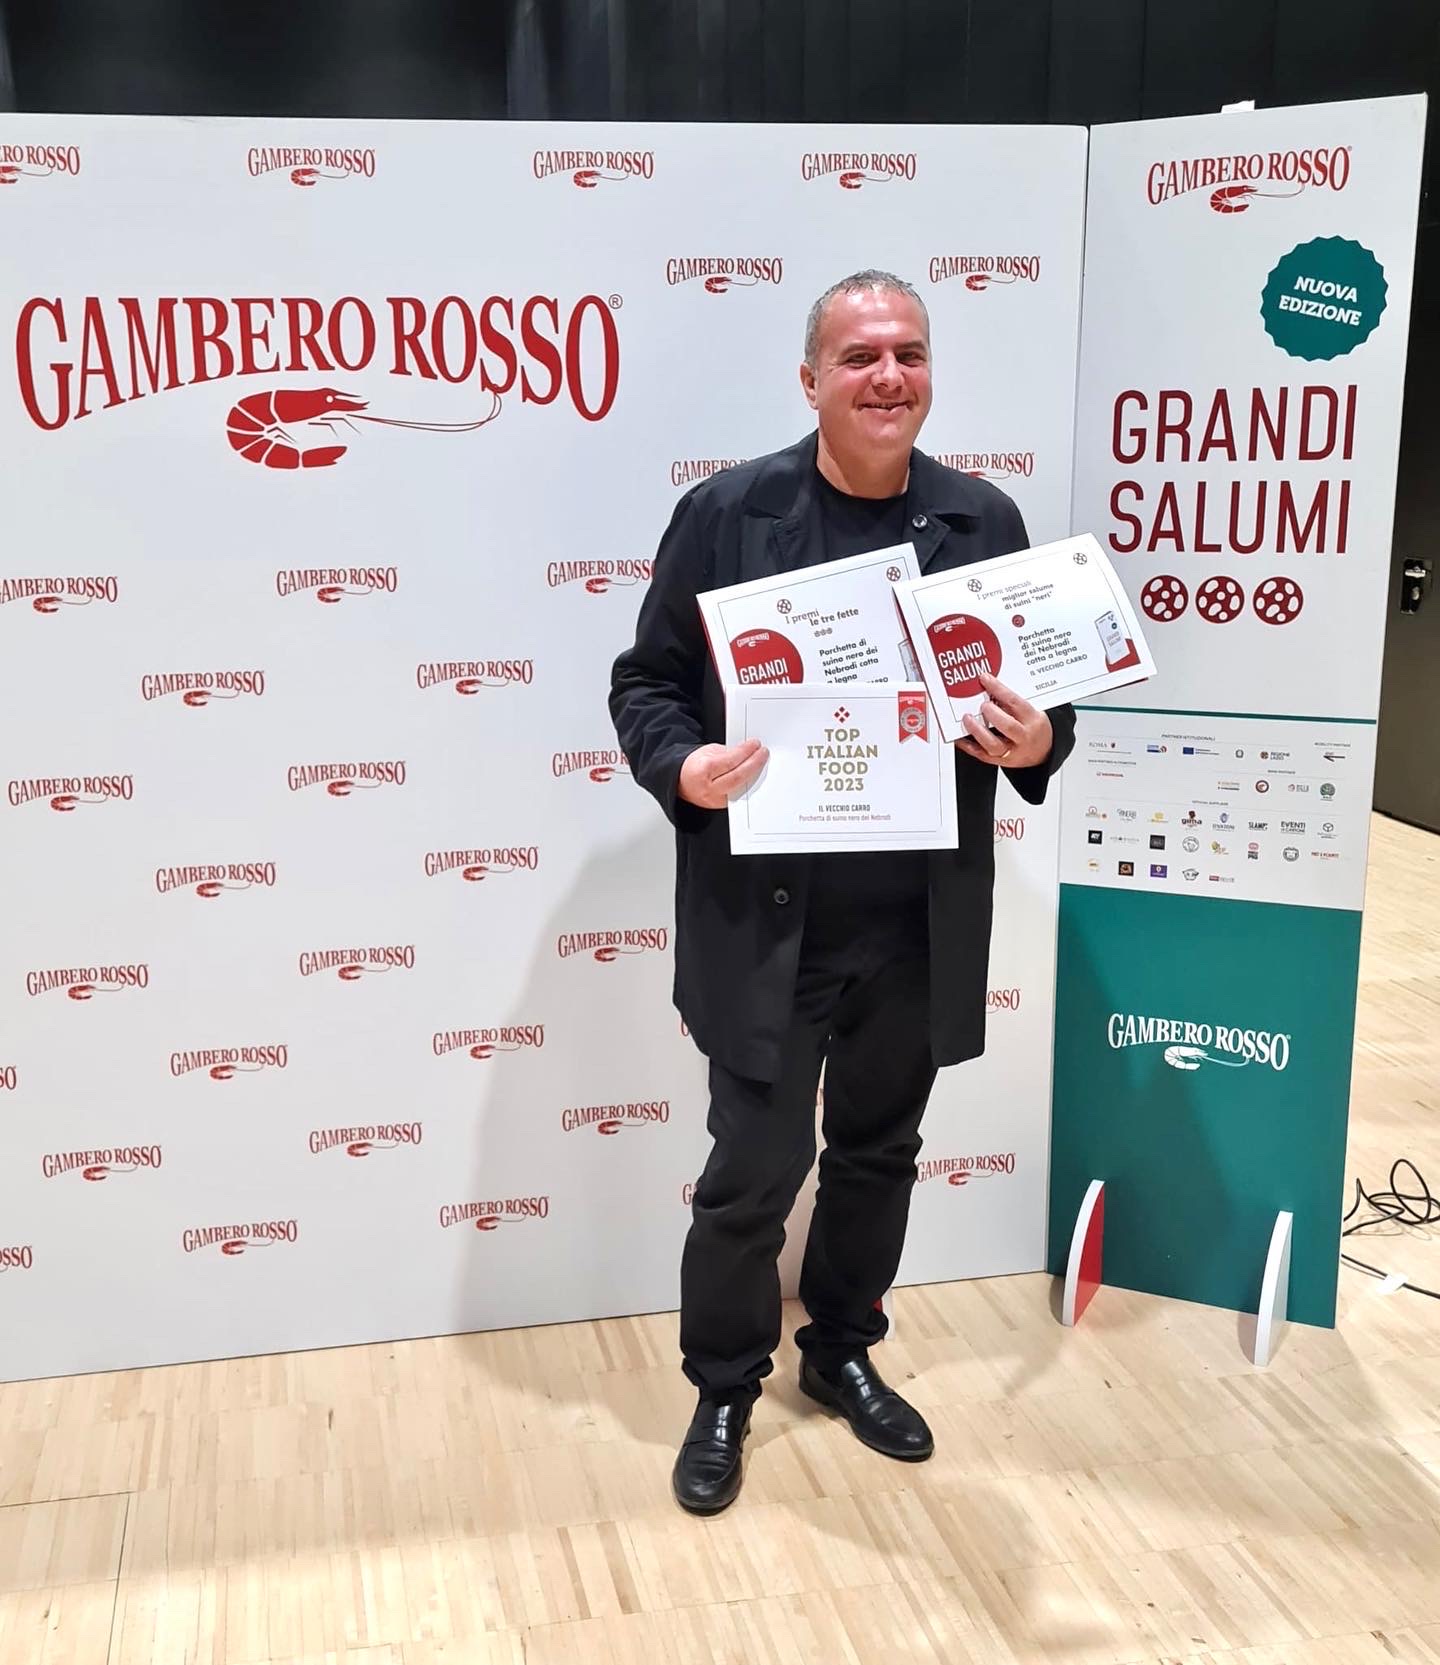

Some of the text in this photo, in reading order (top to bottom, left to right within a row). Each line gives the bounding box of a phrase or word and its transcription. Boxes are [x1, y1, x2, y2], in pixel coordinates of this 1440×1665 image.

[26, 144, 80, 176] ROSSO
[248, 148, 376, 178] GAMBERO ROSSO
[533, 151, 654, 180] GAMBERO ROSSO
[802, 153, 916, 181] GAMBERO ROSSO
[1148, 146, 1352, 205] GAMBERO ROSSO
[667, 257, 783, 285] GAMBERO ROSSO
[929, 255, 1040, 283] GAMBERO ROSSO
[1293, 276, 1358, 304] NUOVA
[1278, 294, 1363, 326] EDIZIONE
[15, 296, 376, 431] GAMBERO
[1111, 384, 1358, 464] GRANDI
[991, 452, 1034, 478] ROSSO
[1108, 479, 1352, 555] SALUMI
[277, 567, 398, 597] GAMBERO ROSSO
[547, 560, 615, 588] GAMBERO
[0, 576, 118, 602] AMBERO ROSSO
[1002, 583, 1054, 602] miglior salume
[1013, 598, 1031, 608] suini
[791, 608, 820, 624] premi
[820, 614, 835, 624] tre
[837, 608, 859, 620] fette
[819, 638, 867, 656] Porchetta di
[1018, 628, 1055, 643] Porchetta
[1021, 631, 1072, 650] di suino nero
[1024, 637, 1070, 658] dei Nebrodi
[822, 646, 878, 667] suino nero dei
[824, 657, 879, 677] Nebrodi cotta
[938, 640, 986, 669] GRANDI
[1027, 655, 1046, 665] cotta
[1055, 646, 1078, 656] legna
[1036, 661, 1065, 674] VECCHIO
[1065, 654, 1088, 665] CARRO
[417, 659, 533, 689] GAMBERO ROSSO
[740, 657, 788, 684] GRANDI
[834, 673, 858, 684] legna
[944, 658, 992, 686] SALUMI
[142, 671, 265, 701] GAMBERO ROSSO
[825, 728, 861, 743] TOP
[552, 751, 618, 778] GAMBERO
[807, 745, 878, 759] ITALIAN
[288, 761, 405, 791] GAMBERO ROSSO
[818, 761, 868, 776] FOOD
[8, 775, 133, 806] GAMBERO ROSSO
[823, 777, 864, 792] 2023
[825, 804, 850, 812] VECCHIO
[851, 804, 871, 812] CARRO
[425, 847, 538, 876] GAMBERO ROSSO
[156, 862, 276, 893] GAMBERO ROSSO
[558, 928, 668, 958] GAMBERO ROSSO
[300, 946, 415, 977] GAMBERO ROSSO
[27, 964, 149, 996] GAMBERO ROSSO
[433, 1024, 544, 1056] GAMBERO ROSSO
[1108, 1013, 1291, 1071] GAMBERO ROSSO
[171, 1045, 288, 1077] GAMBERO ROSSO
[562, 1101, 669, 1132] GAMBERO ROSSO
[309, 1122, 422, 1153] GAMBERO ROSSO
[42, 1145, 162, 1178] GAMBERO ROSSO
[917, 1152, 1015, 1183] GAMBERO ROSSO
[440, 1197, 549, 1228] GAMBERO ROSSO
[183, 1220, 298, 1253] GAMBERO ROSSO
